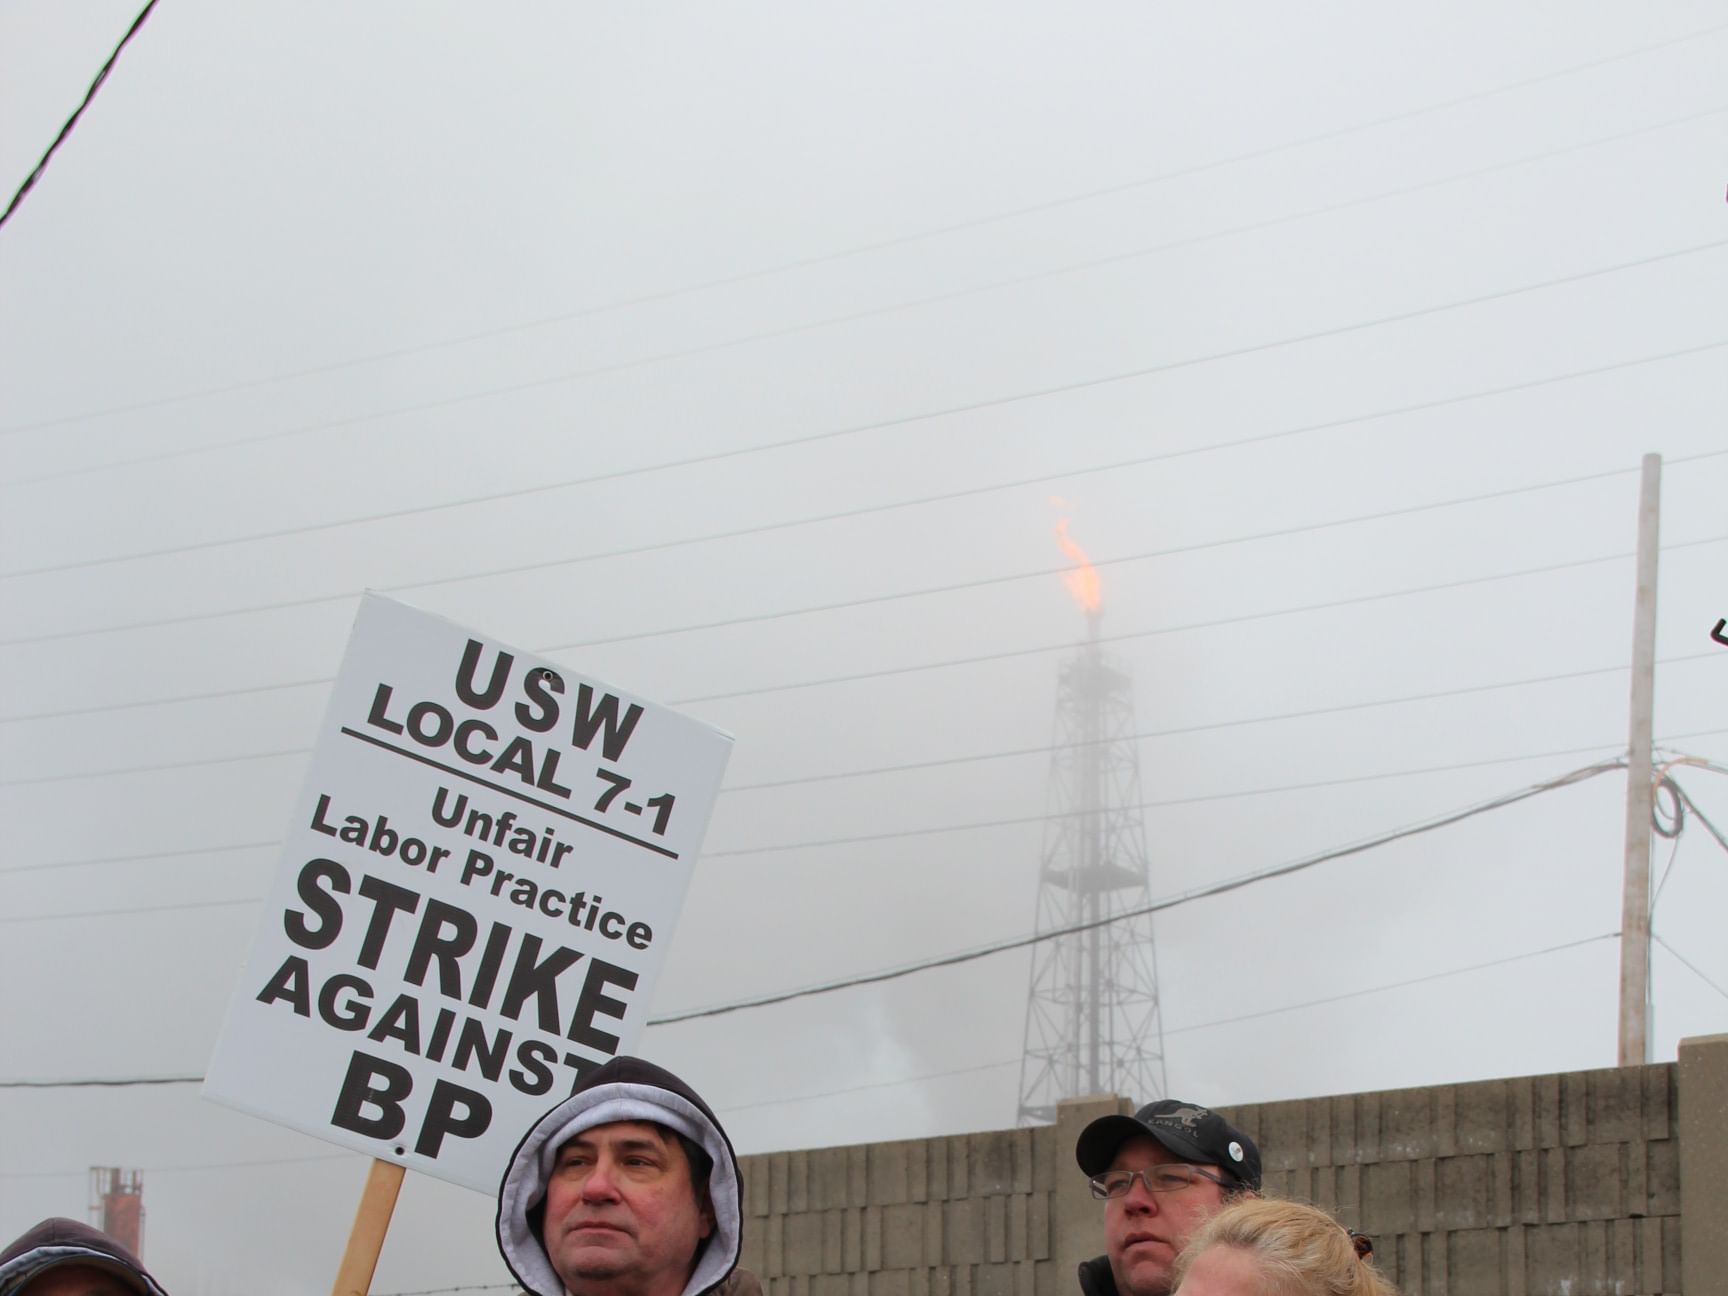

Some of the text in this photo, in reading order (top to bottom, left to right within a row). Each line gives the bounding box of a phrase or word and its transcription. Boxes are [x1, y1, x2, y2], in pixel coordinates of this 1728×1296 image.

[368, 684, 675, 835] LOCAL 7-1
[456, 639, 644, 762] USW
[311, 794, 652, 949] Labor Practice
[432, 787, 573, 868] Unfair
[284, 859, 638, 1055] STRIKE
[331, 1050, 492, 1159] BP
